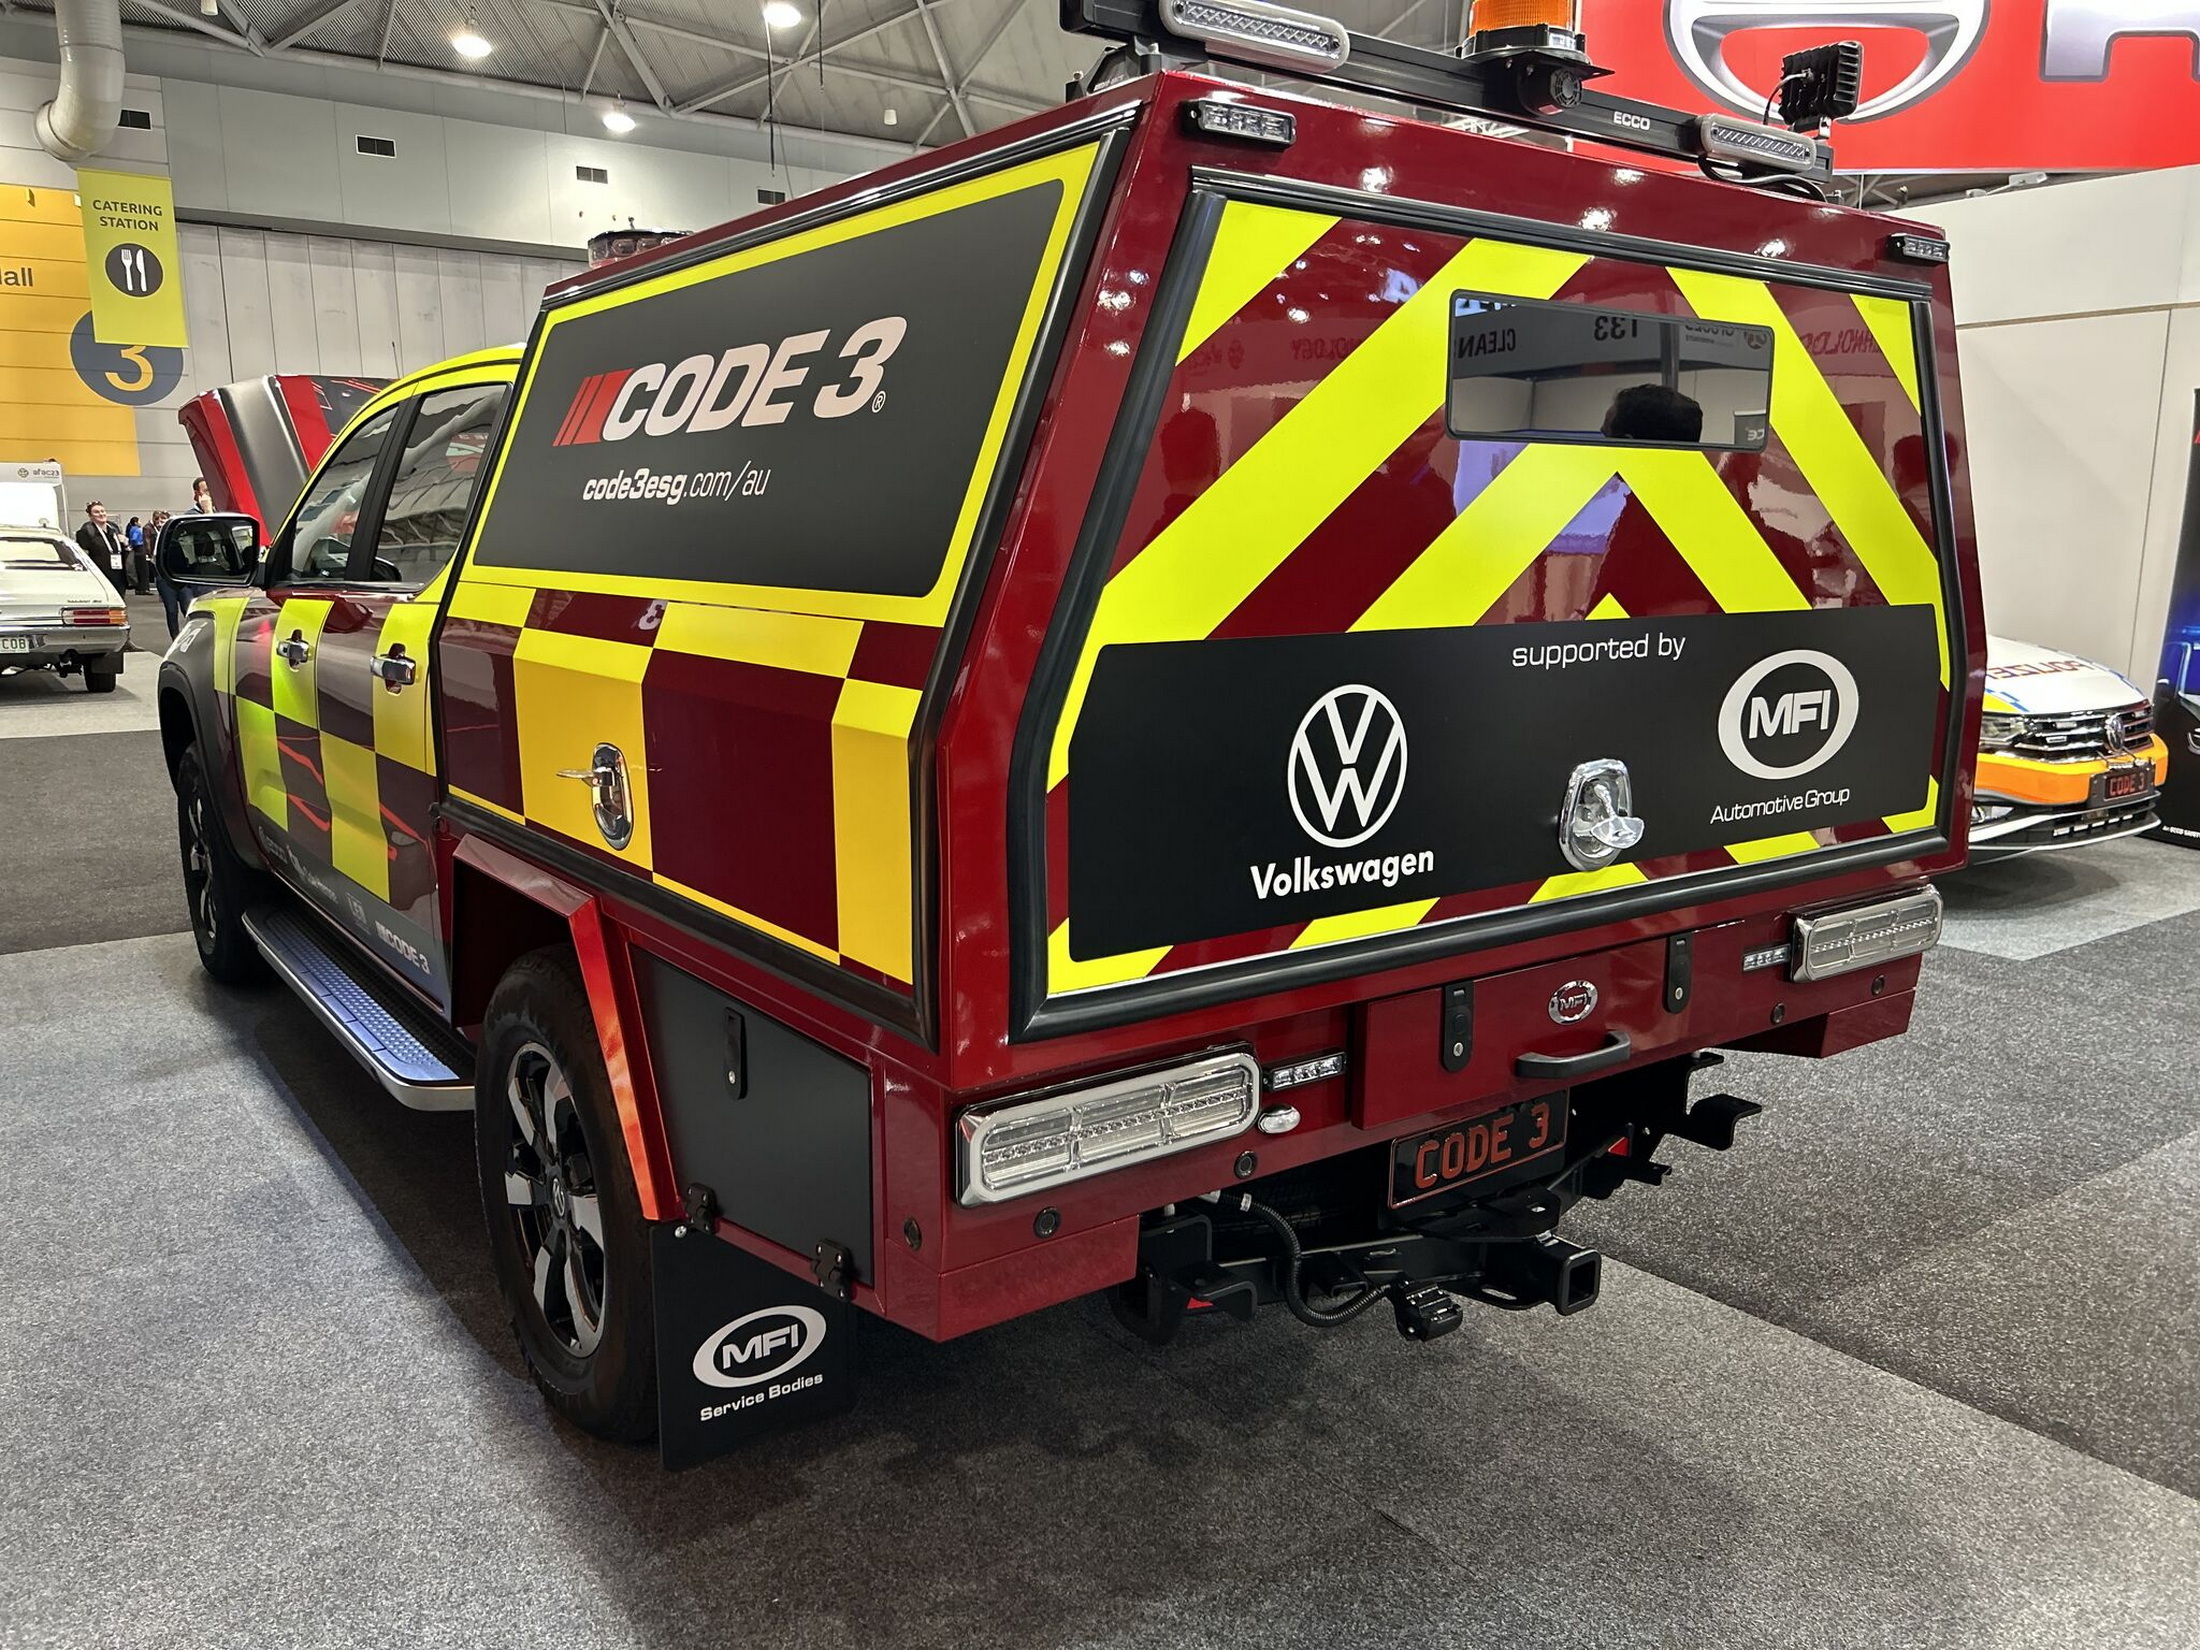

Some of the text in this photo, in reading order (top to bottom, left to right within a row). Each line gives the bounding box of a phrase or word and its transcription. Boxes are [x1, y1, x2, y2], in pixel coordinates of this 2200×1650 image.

[1613, 111, 1650, 131] ECCO
[92, 199, 163, 217] CATERING
[99, 215, 160, 232] STATION
[0, 267, 34, 287] all
[602, 316, 907, 441] CODE 3
[583, 460, 771, 505] code3esg.com/au
[1511, 631, 1687, 670] supported by
[1747, 689, 1832, 741] MFI
[1709, 786, 1851, 825] Automotive Group
[2109, 774, 2136, 796] CODE
[1249, 848, 1435, 900] Volkswagen
[386, 930, 431, 976] CODE 3
[1415, 1103, 1550, 1189] CODE 3
[722, 1323, 799, 1369] MFI
[700, 1373, 824, 1422] Service Bodies
